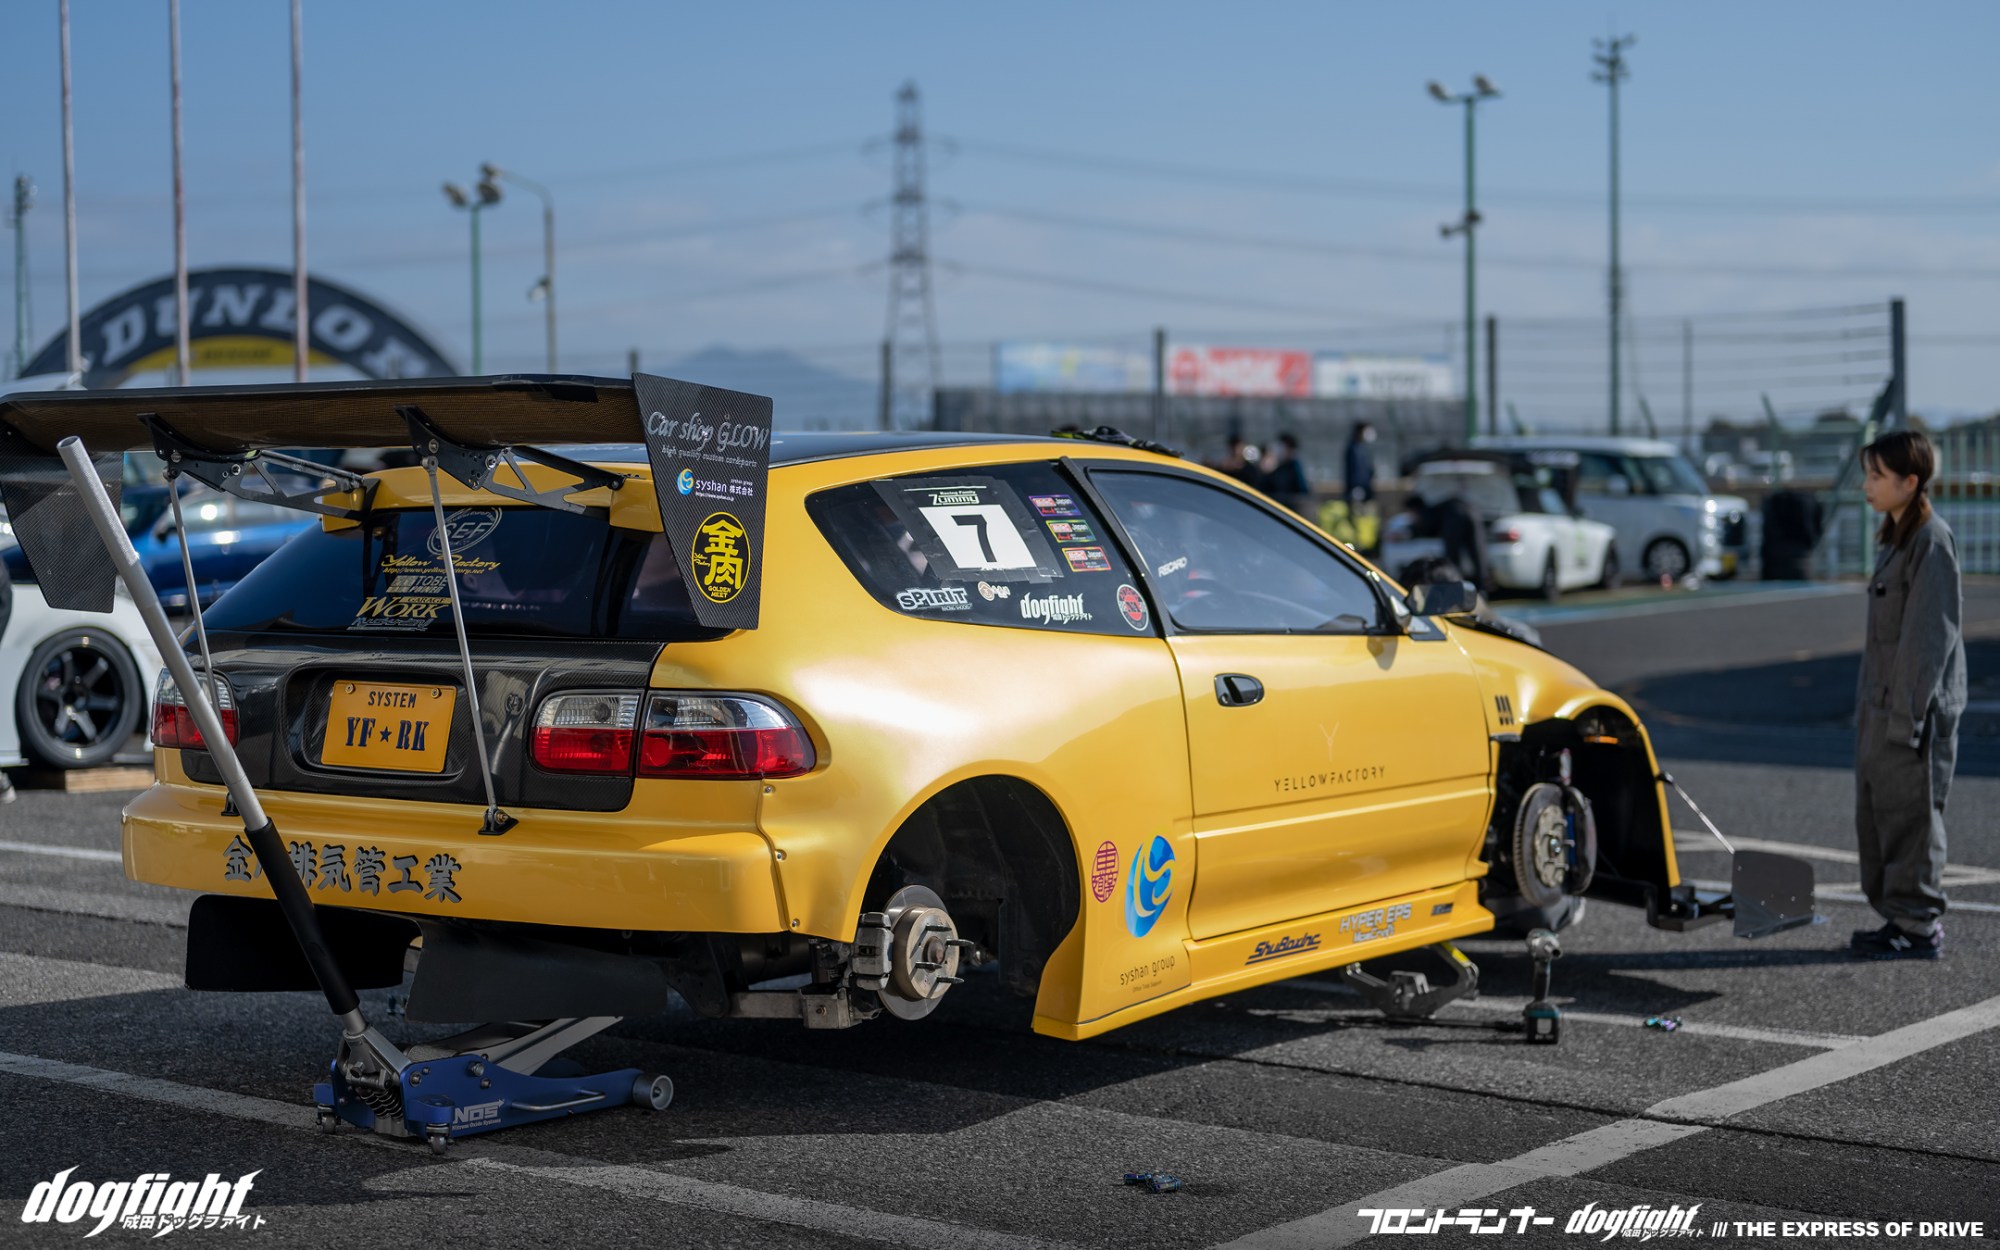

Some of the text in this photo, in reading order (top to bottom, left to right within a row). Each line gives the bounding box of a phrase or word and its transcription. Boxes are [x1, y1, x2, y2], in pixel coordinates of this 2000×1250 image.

[648, 411, 770, 452] Car shop GLOW
[695, 480, 727, 493] syshan
[951, 514, 997, 563] 7
[381, 554, 431, 567] Yellow
[707, 585, 732, 593] GOLDEN
[896, 587, 968, 610] SPIRIT
[356, 596, 449, 619] WORK
[1020, 592, 1084, 625] dogfight
[368, 691, 417, 709] SYSTEM
[1339, 908, 1384, 933] HYPER
[1385, 903, 1412, 924] EPS
[1120, 955, 1176, 986] syshan group
[453, 1100, 503, 1124] NOS
